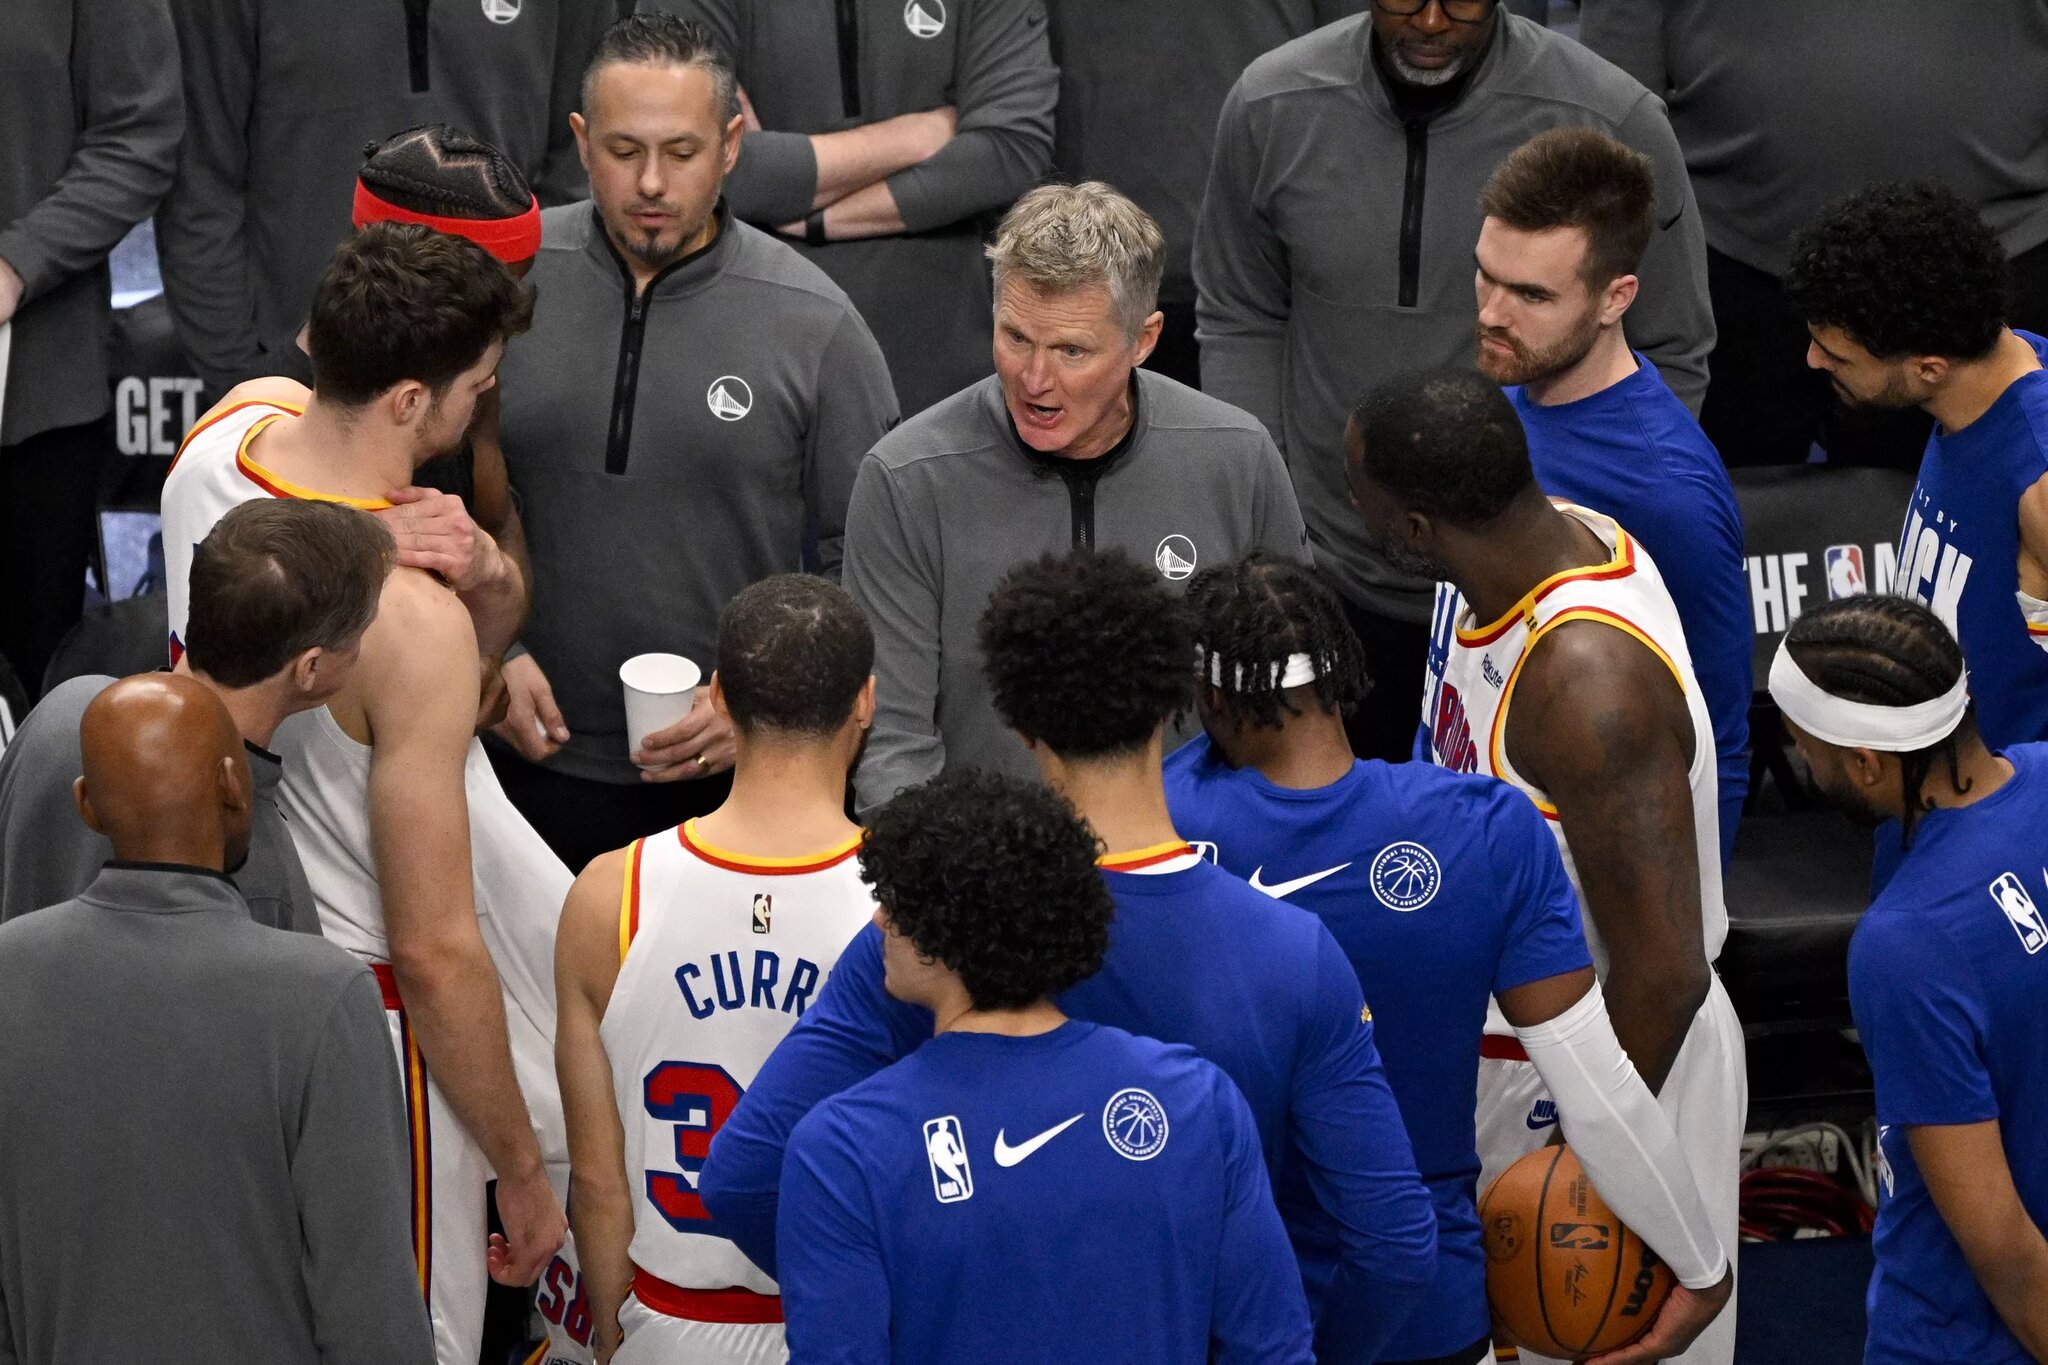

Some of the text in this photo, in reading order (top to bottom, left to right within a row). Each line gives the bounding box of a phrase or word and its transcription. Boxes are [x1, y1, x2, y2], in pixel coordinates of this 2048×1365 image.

[115, 376, 204, 456] GET
[1936, 510, 1958, 533] BY
[675, 949, 822, 1020] CURR
[1532, 1100, 1558, 1118] NIK
